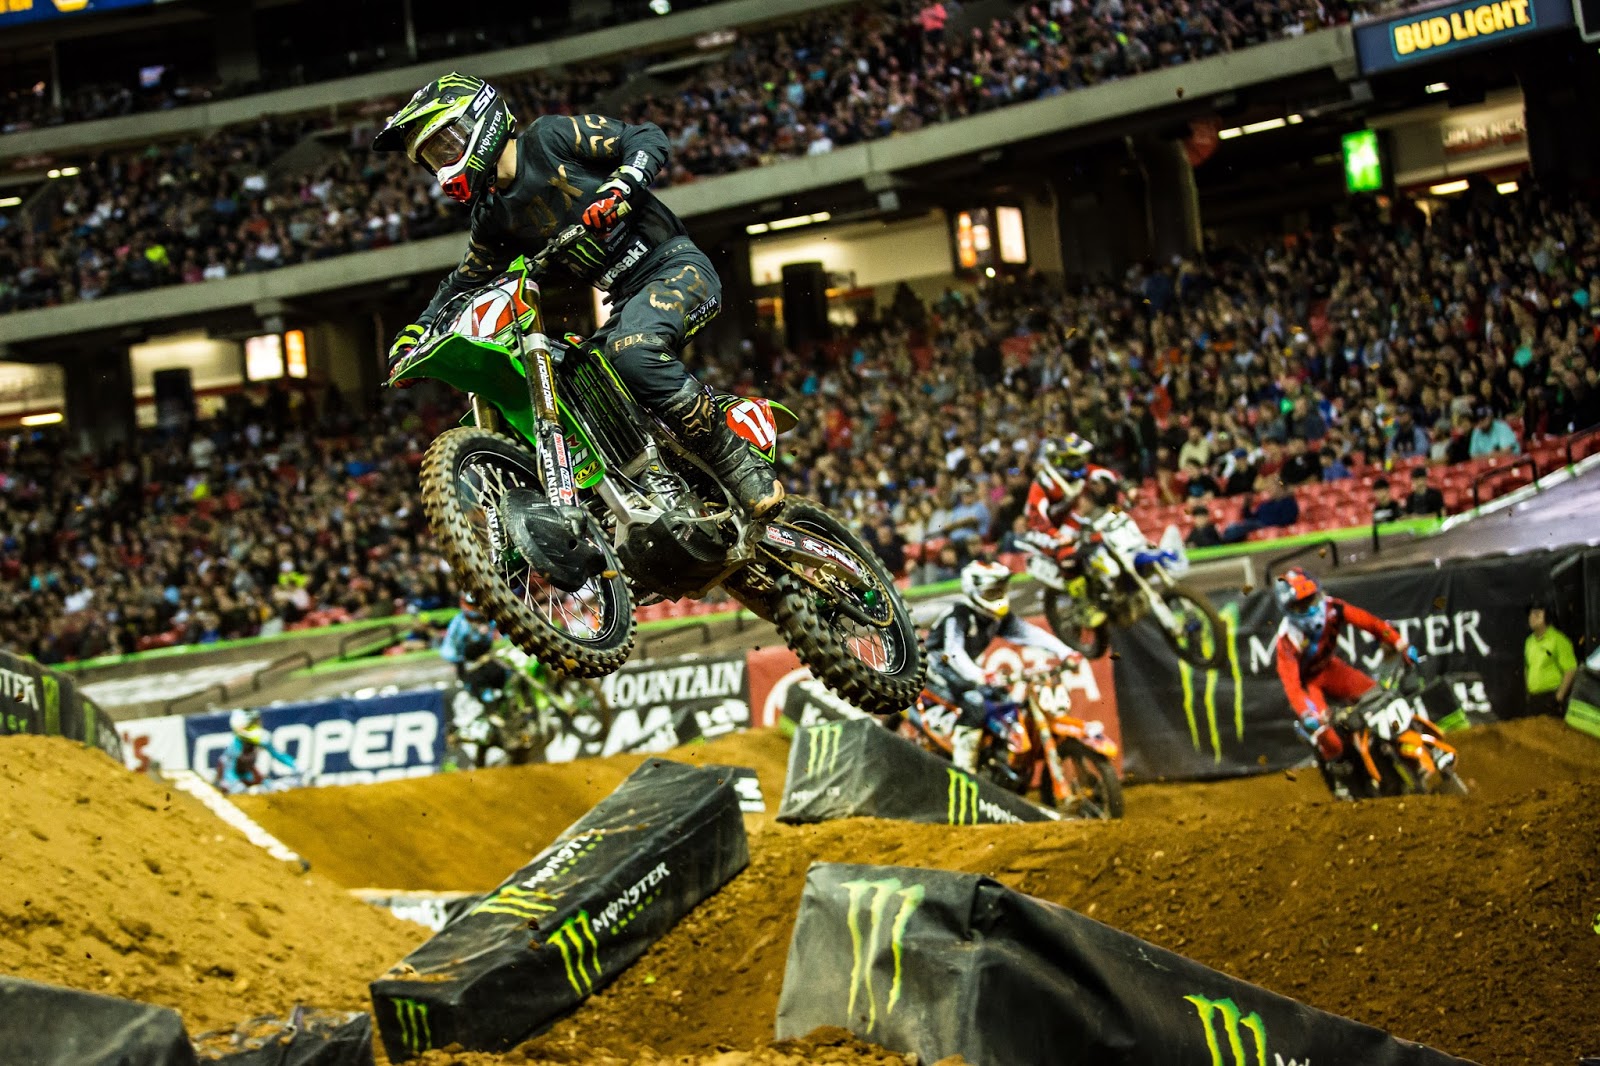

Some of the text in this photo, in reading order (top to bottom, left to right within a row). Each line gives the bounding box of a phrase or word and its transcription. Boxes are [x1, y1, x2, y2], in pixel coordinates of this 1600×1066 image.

[1394, 0, 1530, 55] BUD LIGHT
[477, 110, 503, 155] MONSTER
[598, 240, 649, 291] wasaki
[614, 333, 644, 352] FOX
[730, 400, 775, 449] 17
[1249, 610, 1490, 674] MNSTER
[591, 861, 671, 933] MONSTER
